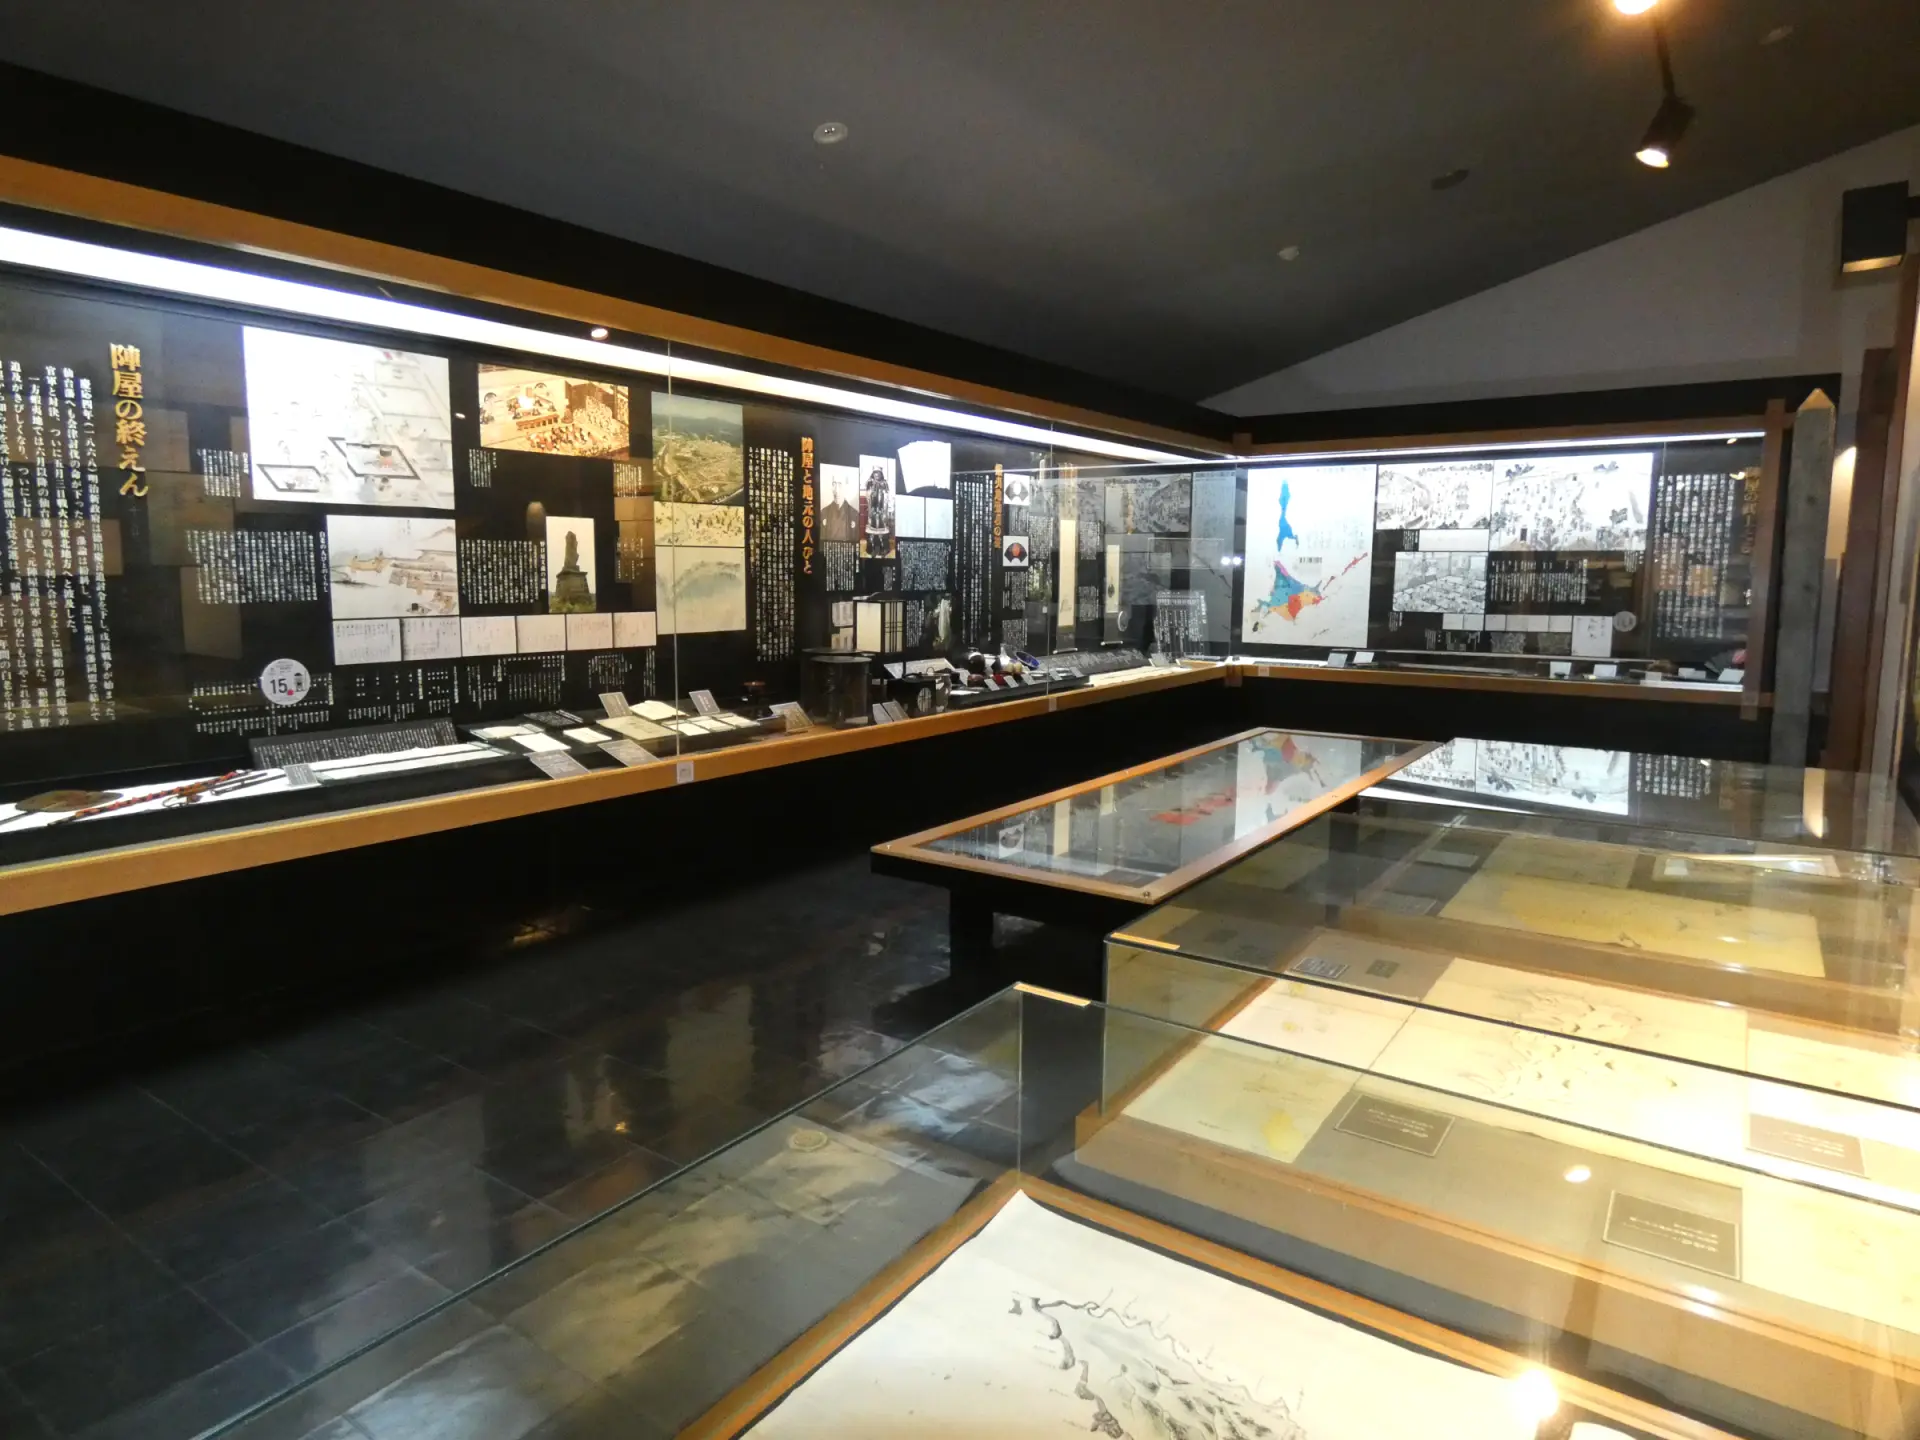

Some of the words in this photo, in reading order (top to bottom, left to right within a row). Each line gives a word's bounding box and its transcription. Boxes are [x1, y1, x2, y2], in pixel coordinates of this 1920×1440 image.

[109, 342, 148, 497] 陣屋の終えん
[801, 437, 815, 575] 陣屋と地元の人びと
[270, 678, 288, 694] 15
